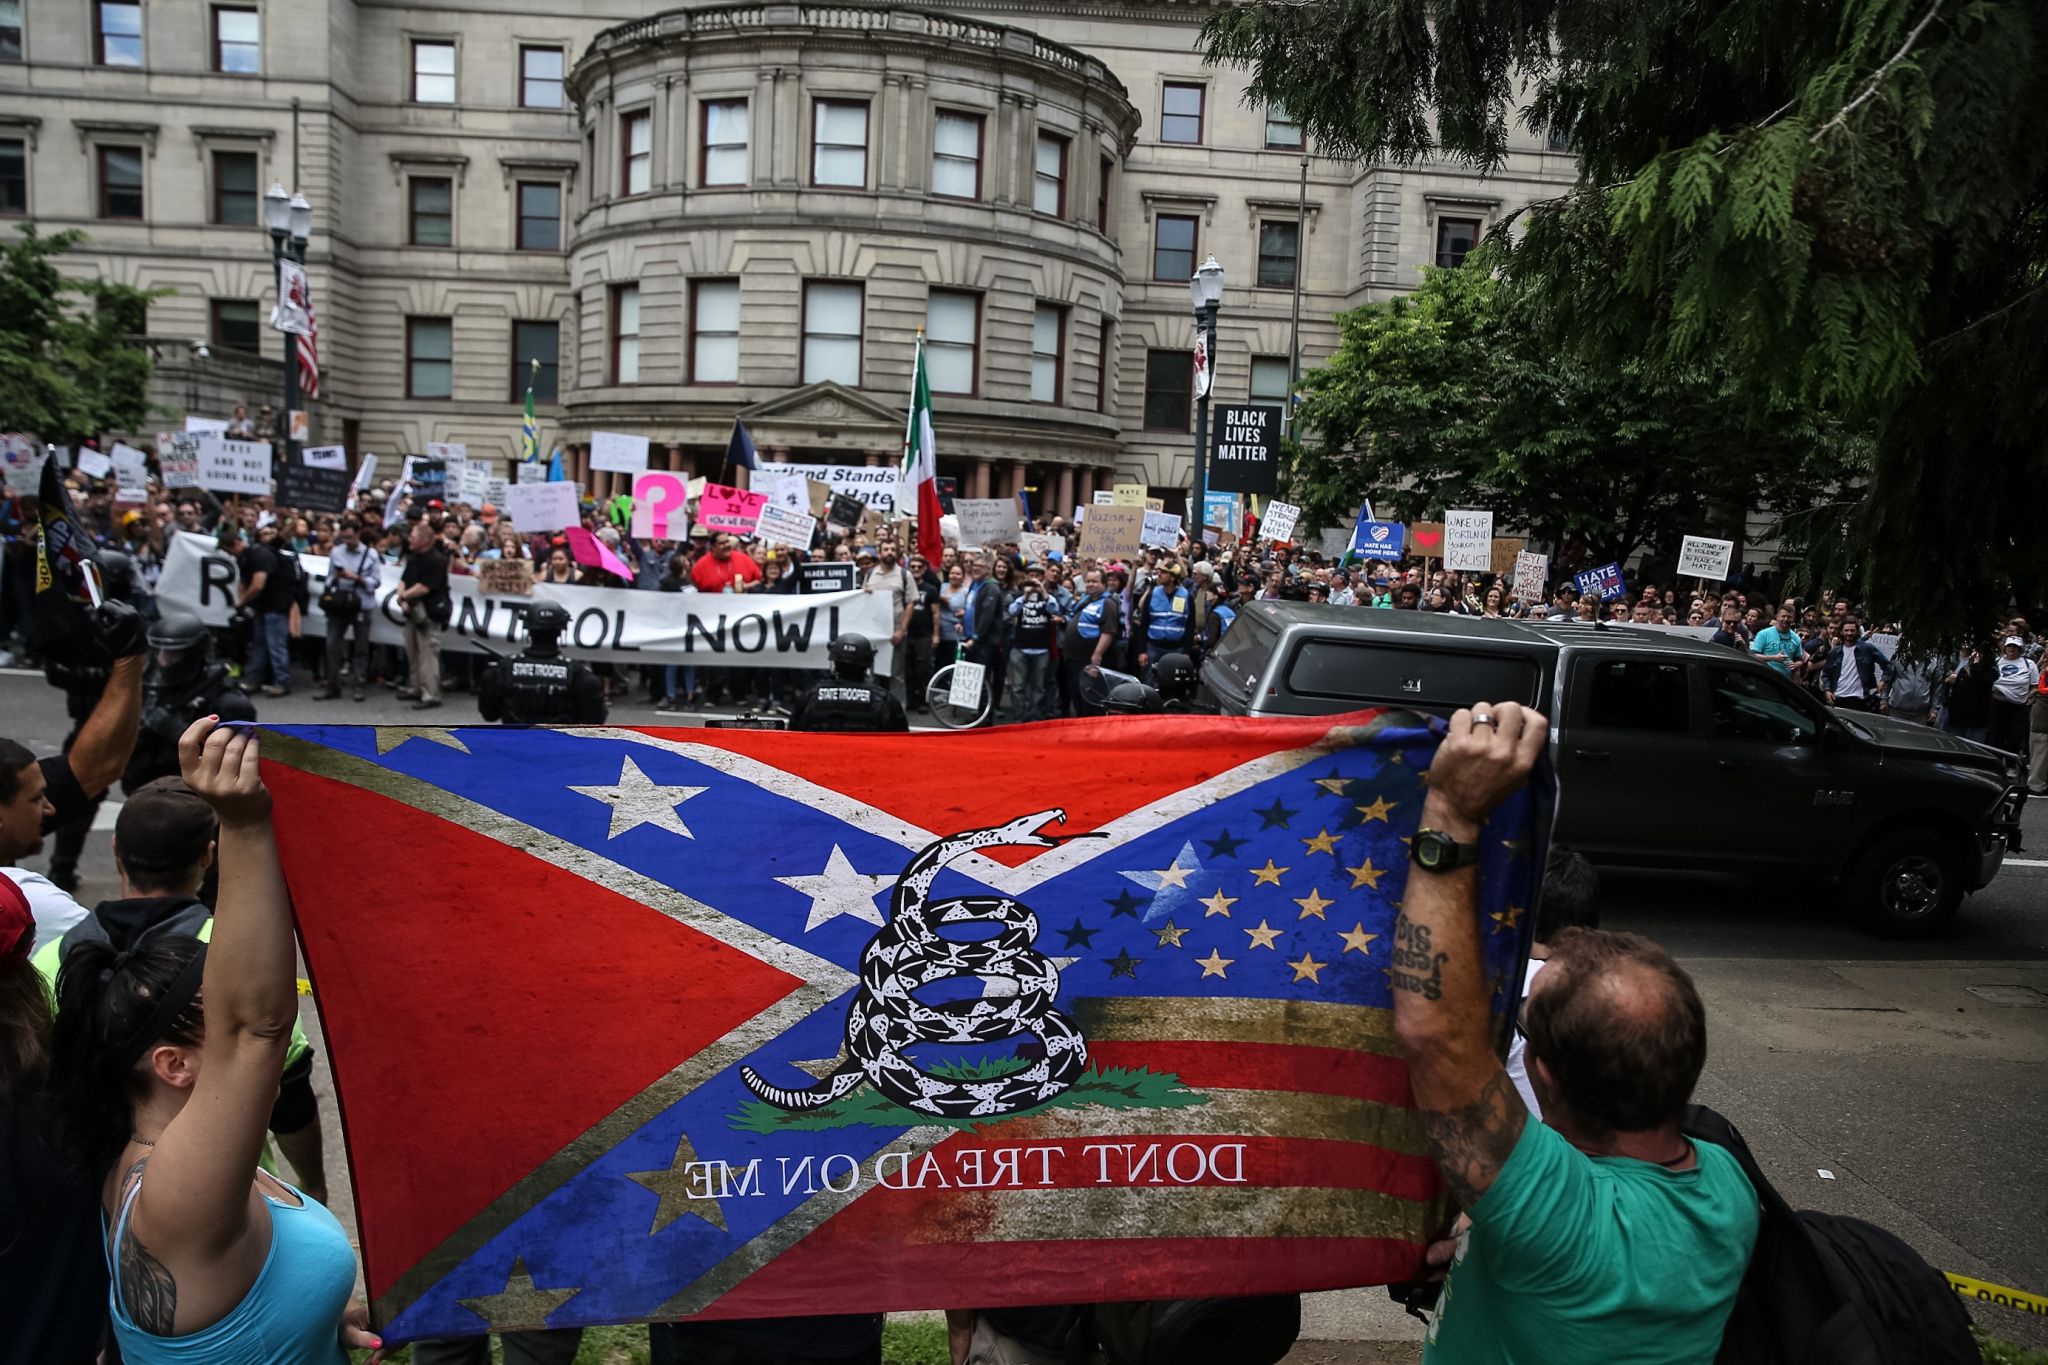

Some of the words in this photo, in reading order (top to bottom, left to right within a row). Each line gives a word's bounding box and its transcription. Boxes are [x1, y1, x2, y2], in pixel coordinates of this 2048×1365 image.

[1226, 410, 1267, 427] BLACK
[1225, 427, 1260, 443] LIVES
[1218, 445, 1267, 461] MATTER
[832, 468, 896, 483] Stands
[726, 503, 741, 514] IS
[1446, 515, 1471, 527] WAKE
[1474, 517, 1489, 528] UP
[1449, 550, 1490, 567] RACIST!
[1579, 565, 1617, 586] HATE
[1601, 585, 1620, 598] EAT
[382, 596, 640, 652] CNTOL
[512, 662, 535, 676] STATE
[535, 663, 567, 678] TROOPER
[818, 688, 838, 701] STATE
[839, 688, 870, 702] TROOPER
